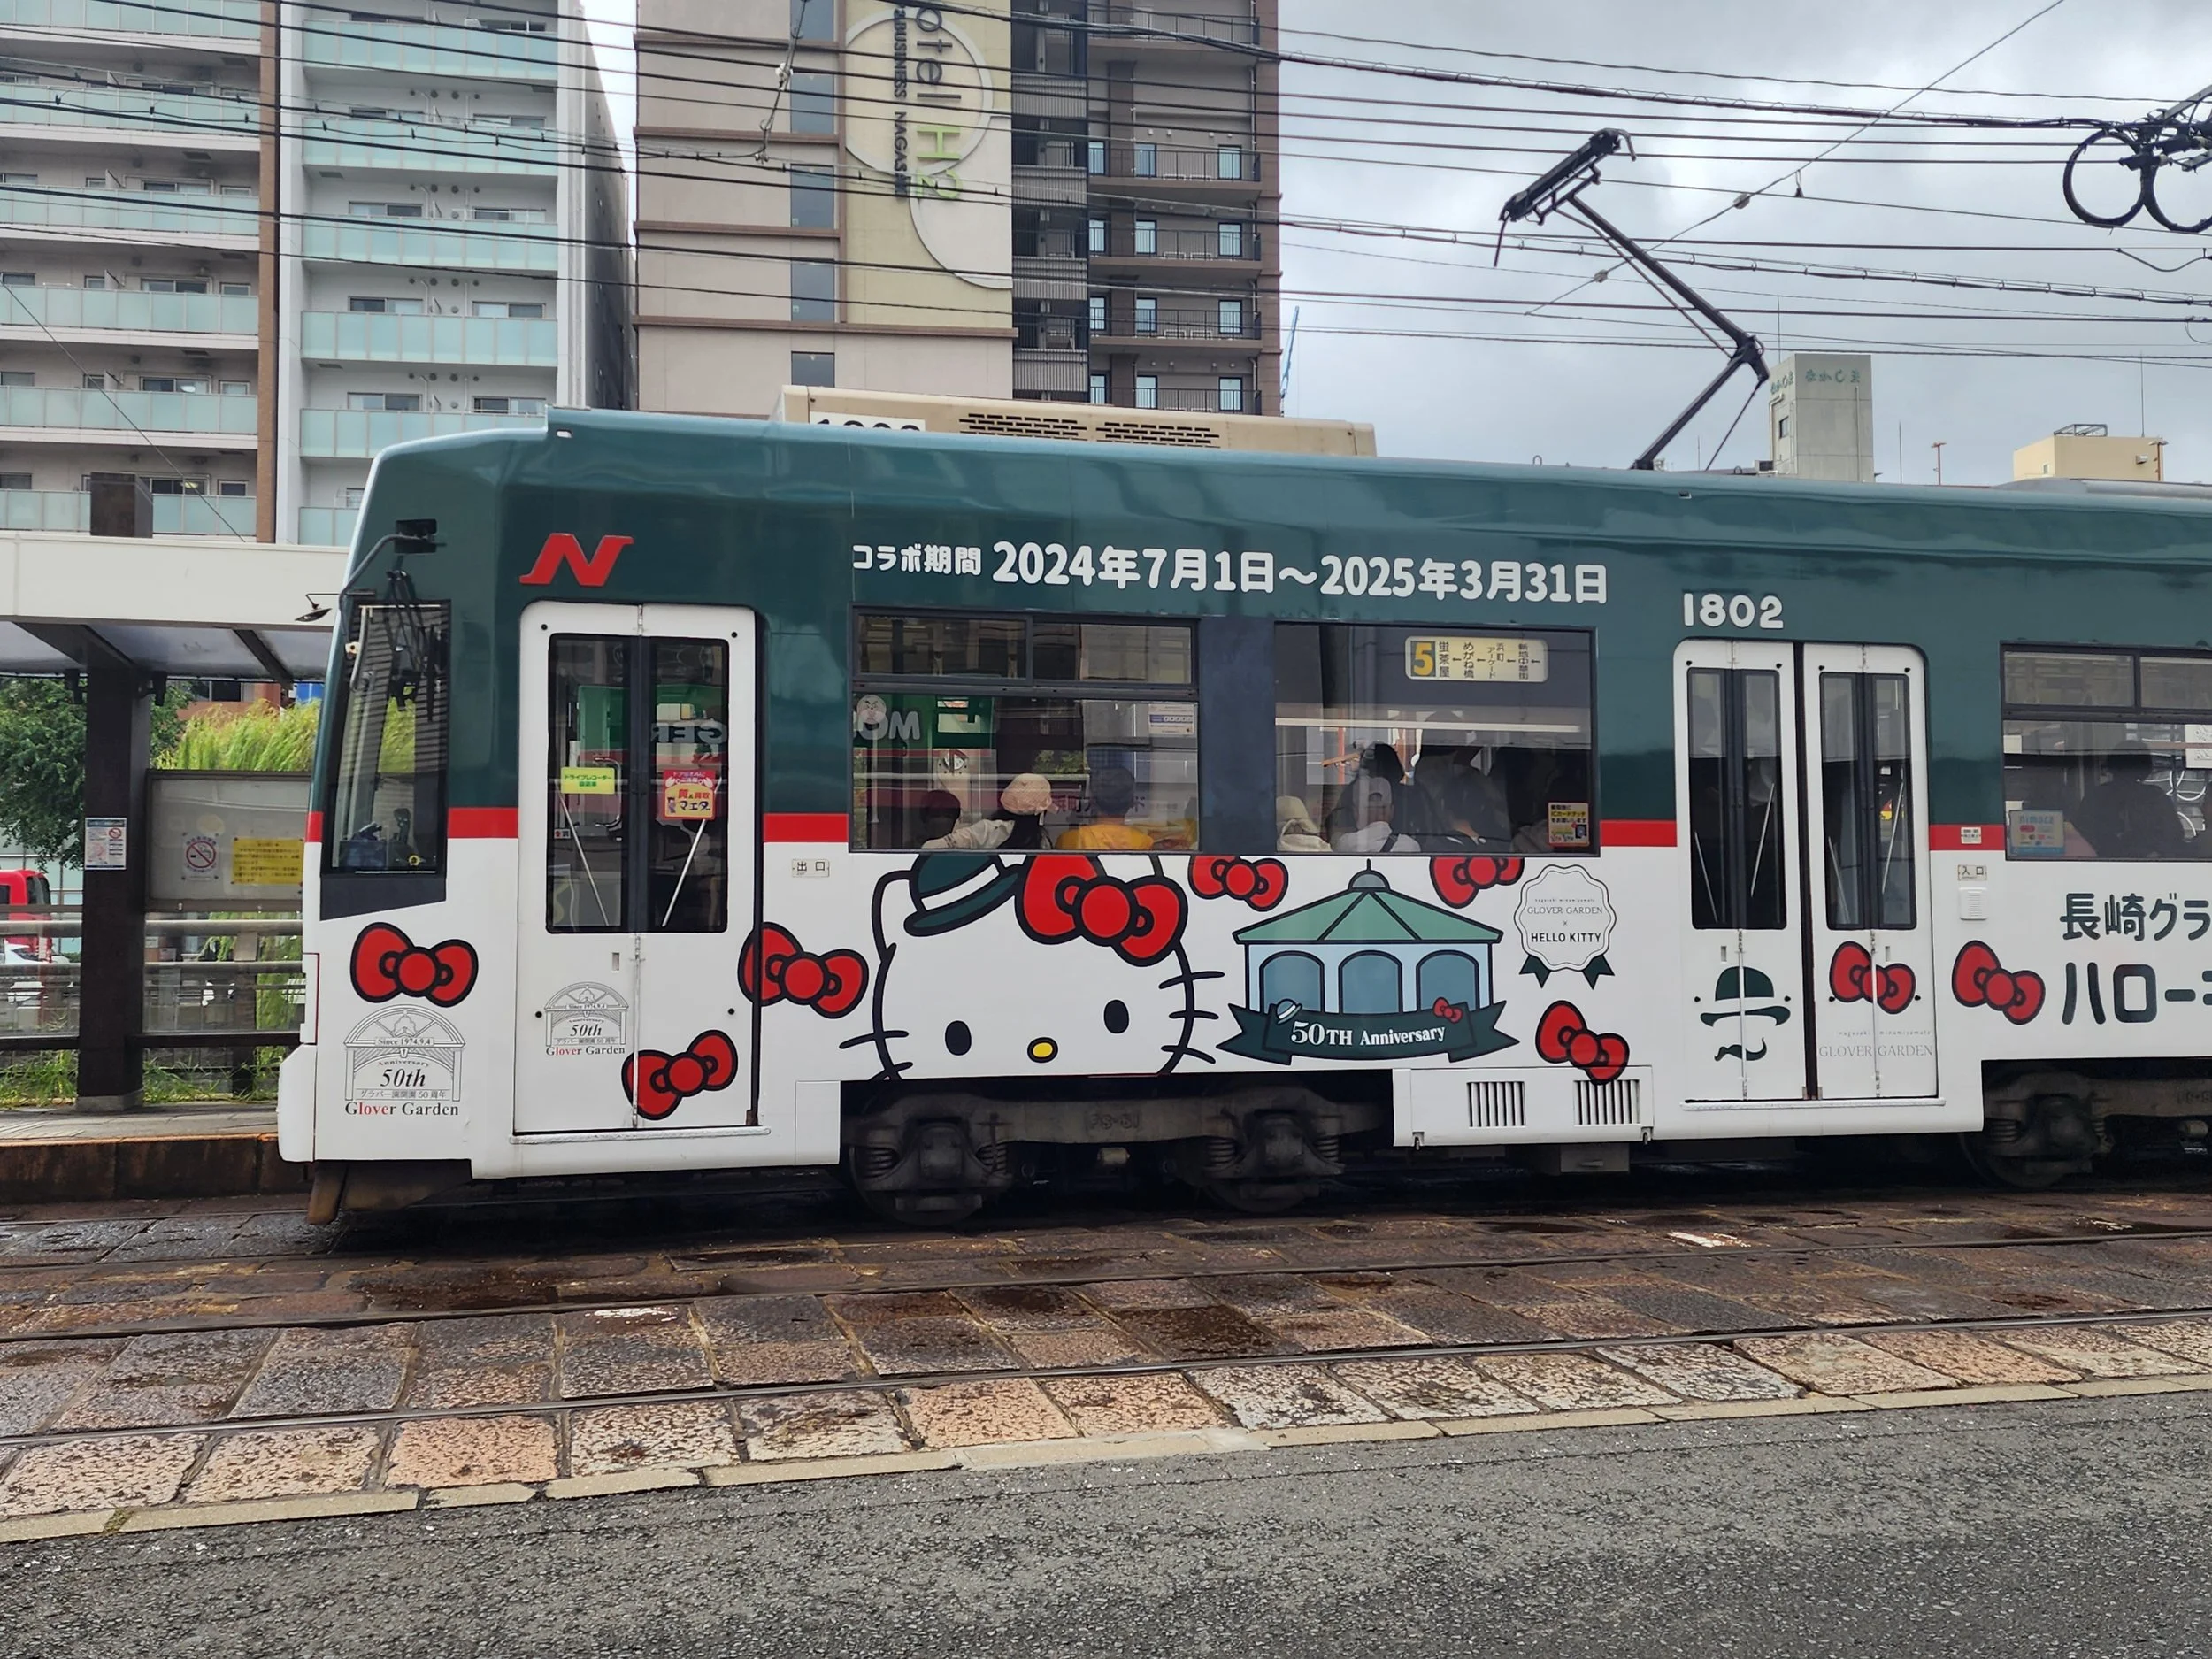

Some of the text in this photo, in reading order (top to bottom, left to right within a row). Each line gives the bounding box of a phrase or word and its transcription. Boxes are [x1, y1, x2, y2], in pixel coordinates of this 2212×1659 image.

[917, 127, 963, 199] H2
[853, 542, 982, 575] コラボ期間
[1684, 593, 1784, 629] 1802
[1413, 642, 1434, 676] 5
[1463, 642, 1474, 679] めがね橋
[796, 861, 826, 872] 出口
[1962, 866, 1985, 875] 入口
[1526, 906, 1603, 915] GLOVER GARDEN
[2060, 892, 2211, 941] 長崎グラ
[1531, 933, 1601, 942] HELLO KITTY
[570, 1024, 603, 1037] 50th
[1291, 1021, 1447, 1046] 50TH Anniversary
[546, 1045, 626, 1056] Glover Garden
[1819, 1044, 1933, 1057] GLOVER GARDEN
[378, 1059, 430, 1068] Anniversary
[380, 1068, 426, 1087] 50th
[345, 1102, 459, 1116] Glover Garden
